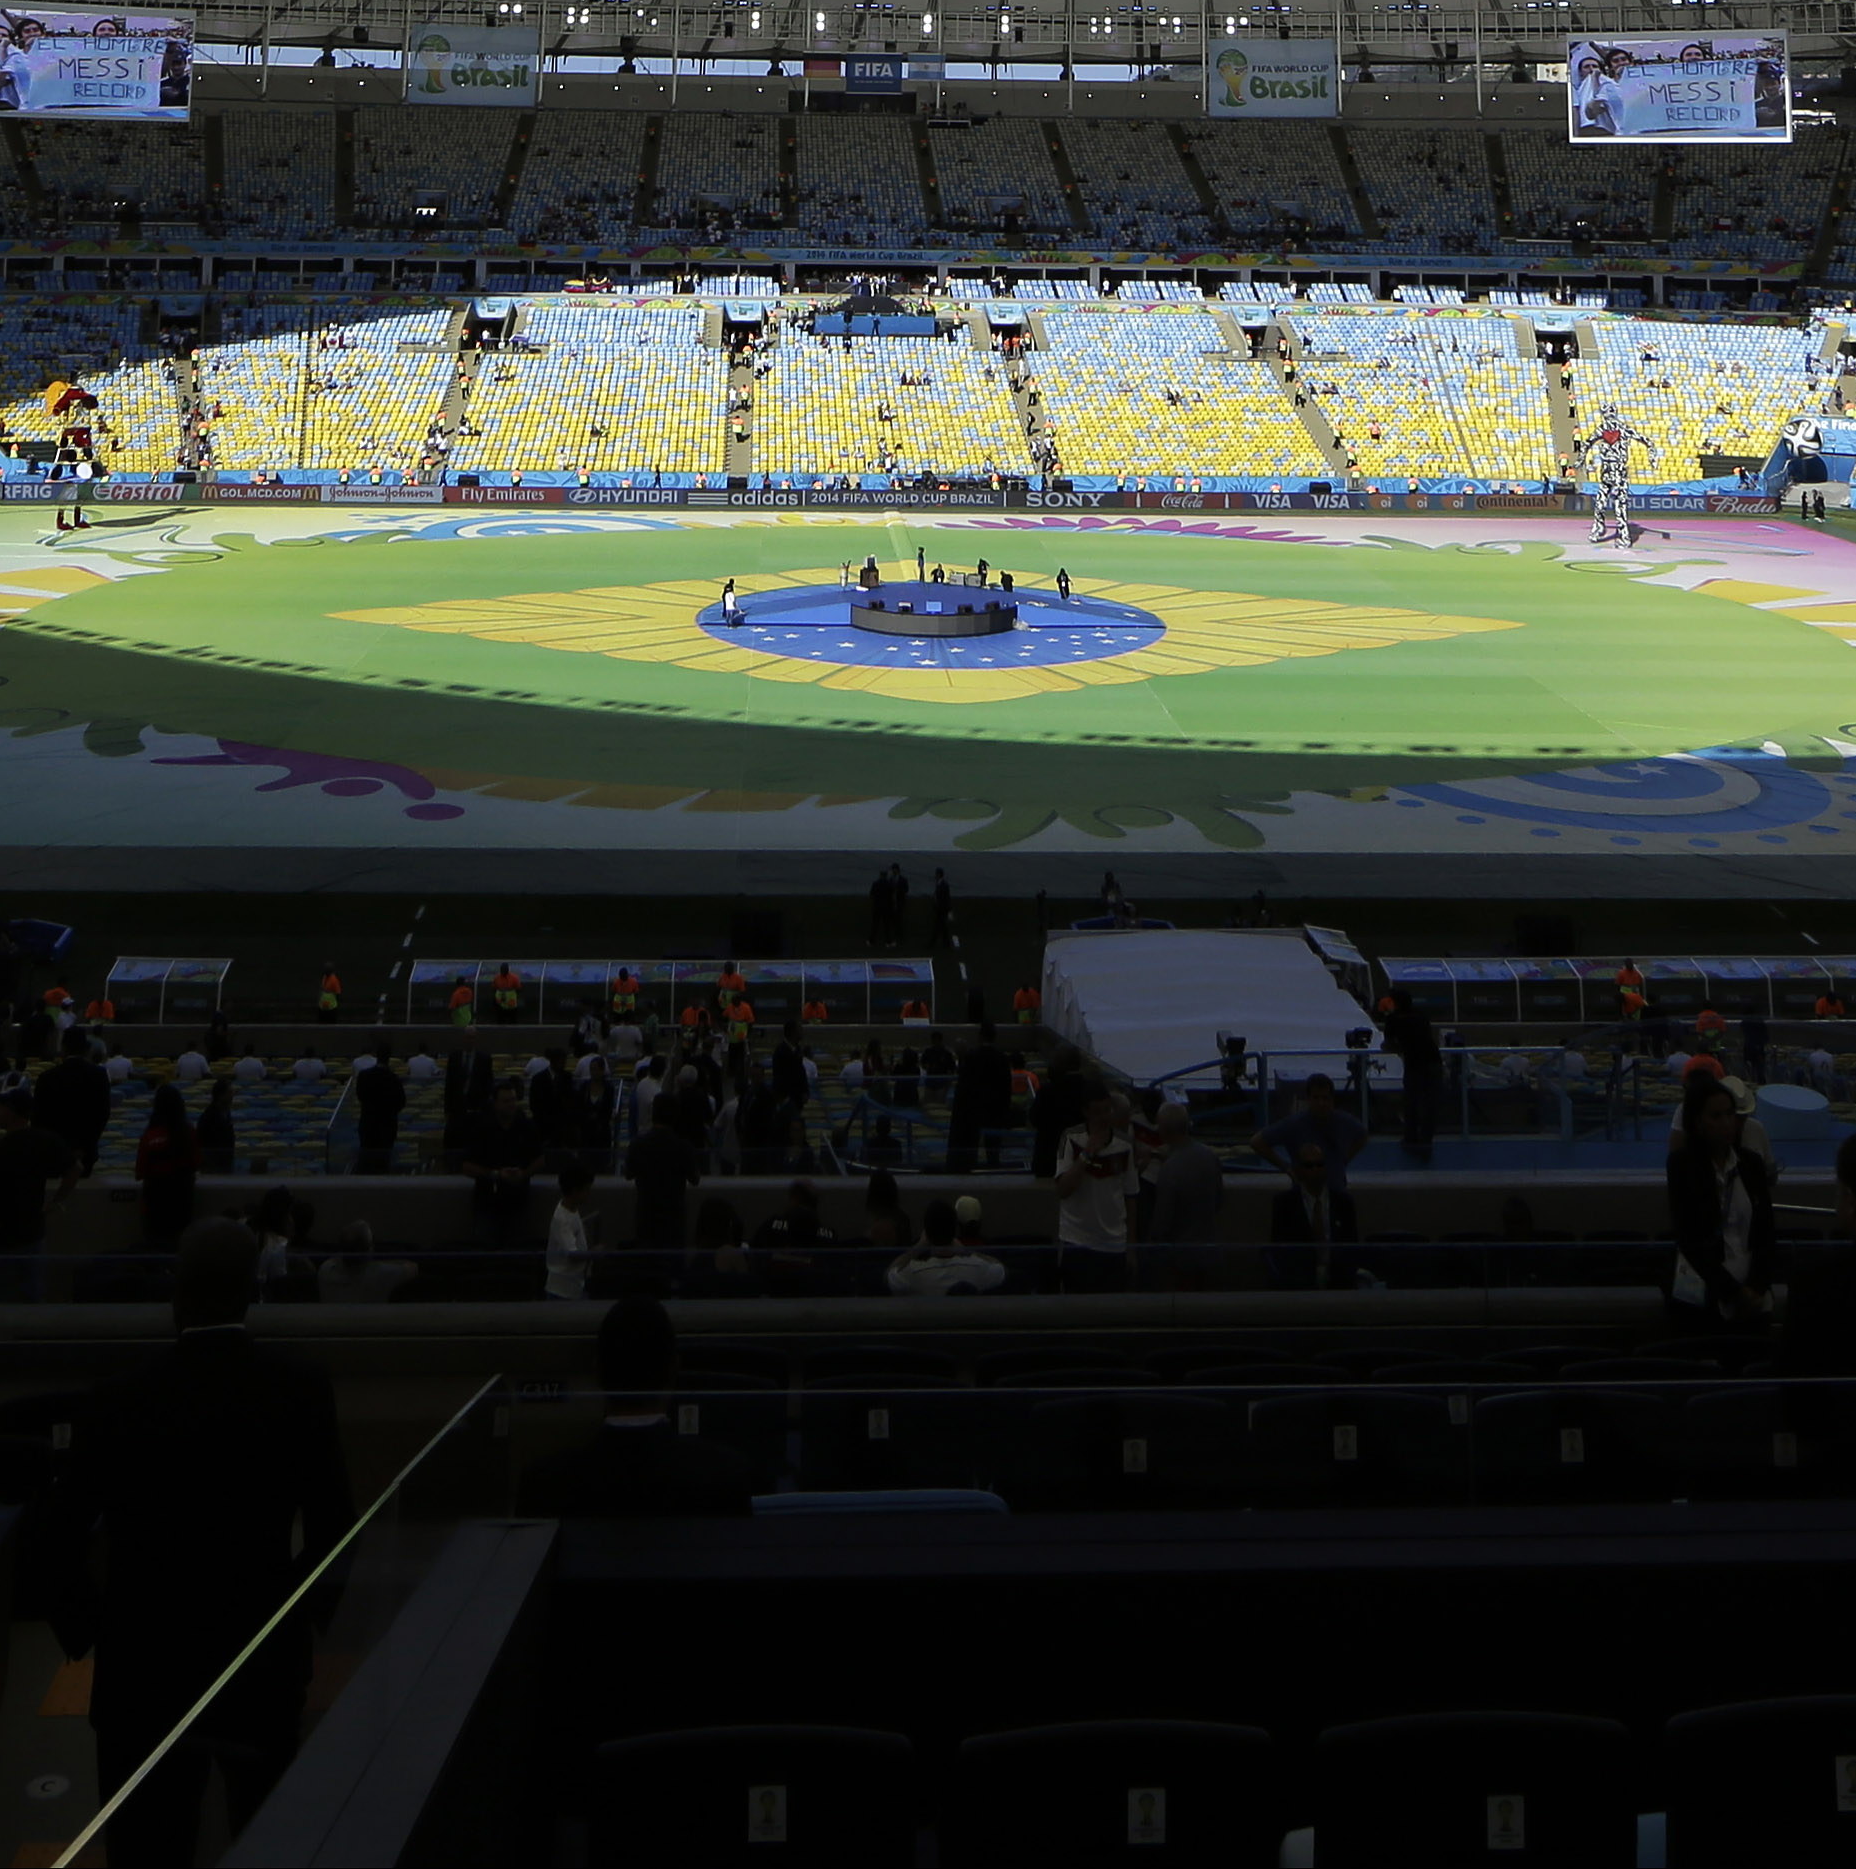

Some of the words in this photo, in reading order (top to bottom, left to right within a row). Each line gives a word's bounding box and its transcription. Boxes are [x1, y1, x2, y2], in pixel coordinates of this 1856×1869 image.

[38, 38, 66, 51] EL
[451, 63, 529, 87] Brasil
[855, 62, 894, 78] FIFA
[1252, 64, 1275, 73] FIFA
[1275, 64, 1309, 73] WORLD
[1310, 64, 1329, 73] CUP
[1627, 65, 1656, 79] EL
[74, 83, 146, 99] RECORD
[1250, 75, 1329, 99] Brasil
[1666, 107, 1740, 121] RECORD
[3, 484, 53, 500] RFRIG
[110, 484, 180, 501] Castrol
[220, 487, 302, 499] GOL.MCD.COM
[461, 488, 484, 503] Fly
[487, 487, 545, 501] Emirates
[599, 490, 678, 504] HYUNDAI
[731, 491, 799, 506] adidas
[811, 492, 839, 503] 2014
[842, 492, 869, 503] FIFA
[872, 492, 918, 504] WORLD
[922, 492, 947, 504] CUP
[950, 492, 995, 505] BRAZIL
[1026, 492, 1104, 508] SONY
[1252, 494, 1291, 509] VISA
[1311, 494, 1351, 509] VISA
[1380, 497, 1391, 509] oi
[1417, 497, 1428, 509] oi
[1453, 497, 1464, 509] oi
[1476, 495, 1548, 509] Continental
[1650, 498, 1704, 510] SOLAR
